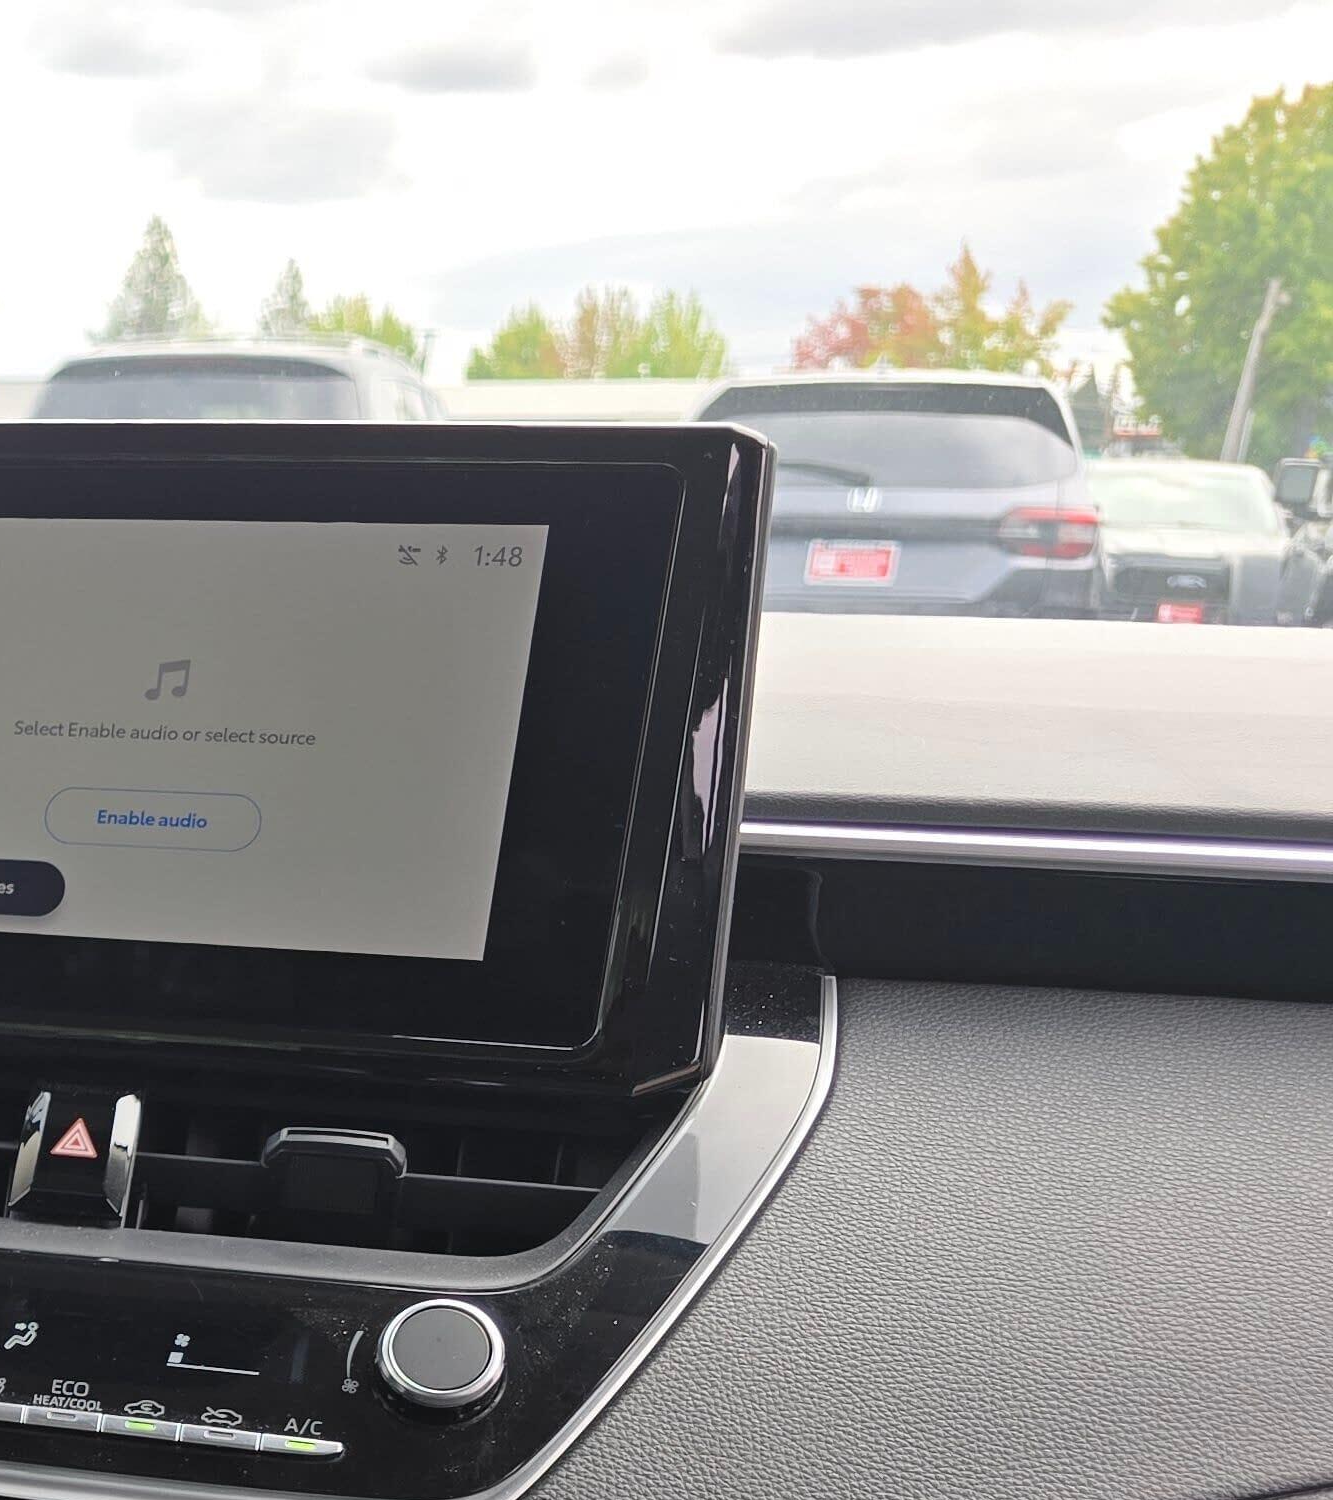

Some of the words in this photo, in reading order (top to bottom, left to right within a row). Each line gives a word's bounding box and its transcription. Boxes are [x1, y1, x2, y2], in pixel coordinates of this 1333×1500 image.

[473, 545, 523, 567] 1:48
[13, 720, 64, 738] Select
[67, 721, 126, 740] Enable
[129, 724, 179, 742] audio
[182, 730, 200, 742] or
[203, 727, 255, 744] select
[258, 730, 316, 746] source
[96, 809, 155, 827] Enable
[157, 812, 208, 829] audio
[51, 1379, 89, 1397] ECO
[33, 1393, 103, 1412] HEAT/COOL
[284, 1418, 324, 1436] A/C
